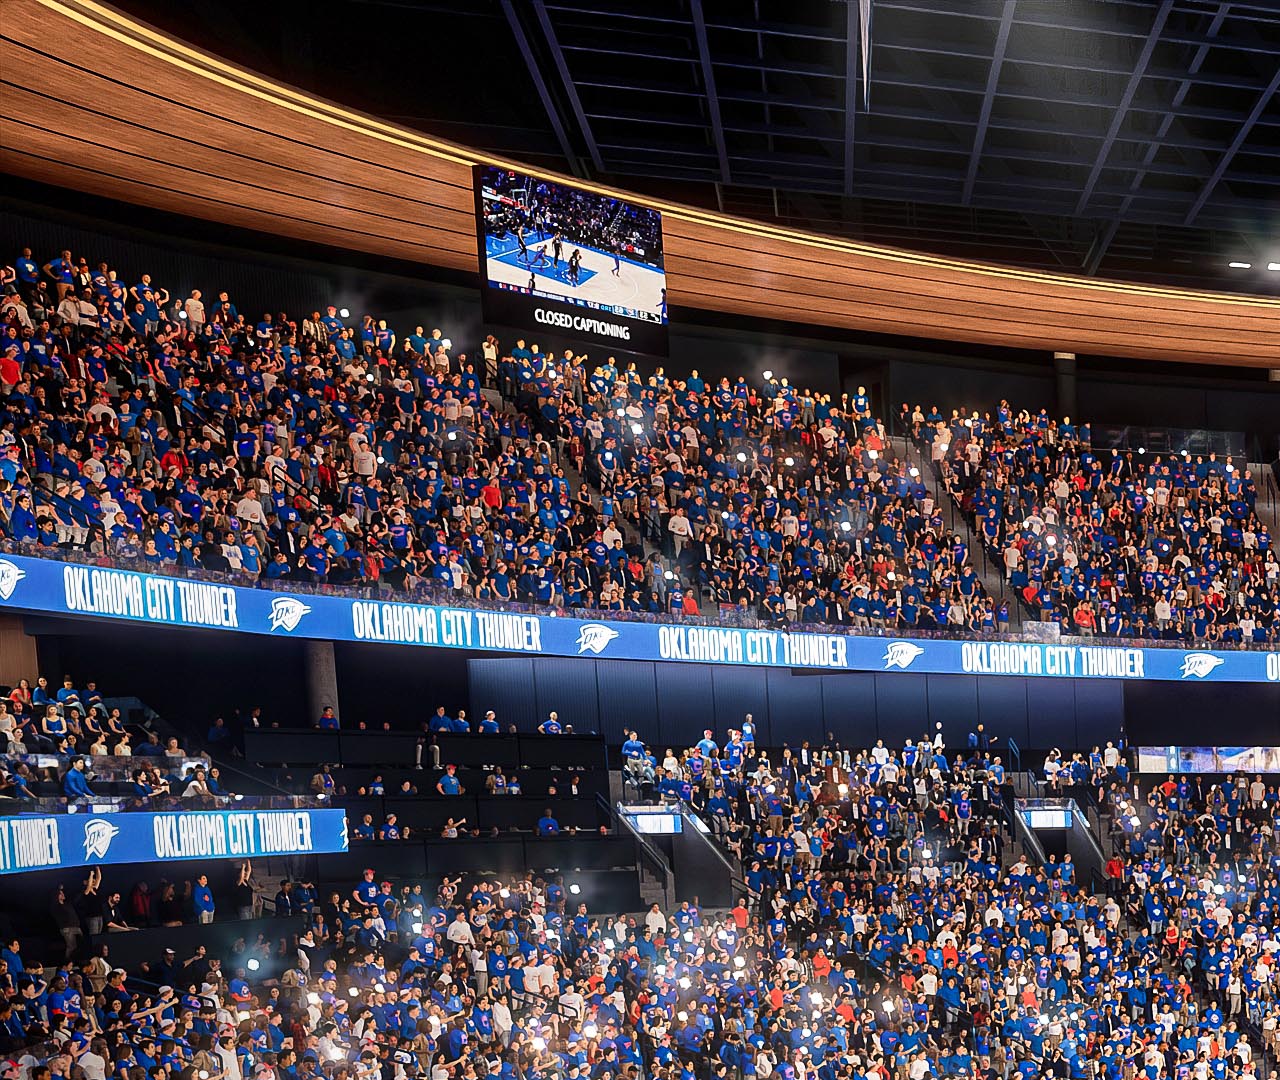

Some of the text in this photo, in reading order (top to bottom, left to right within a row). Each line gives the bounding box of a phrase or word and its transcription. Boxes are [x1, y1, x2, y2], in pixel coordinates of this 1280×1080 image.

[534, 308, 631, 341] CLOSED CAPTIONING
[63, 565, 239, 628] OKLAHOMA CITY THUNDER
[352, 601, 542, 652] OKLAHOMA CITY THUNDER
[659, 626, 848, 668] OKLAHOMA CITY THUNDER
[961, 642, 1145, 678] OKLAHOMA CITY THUNDER
[9, 818, 61, 868] THUNDER
[153, 811, 313, 858] OKLAHOMA CITY THUNDER
